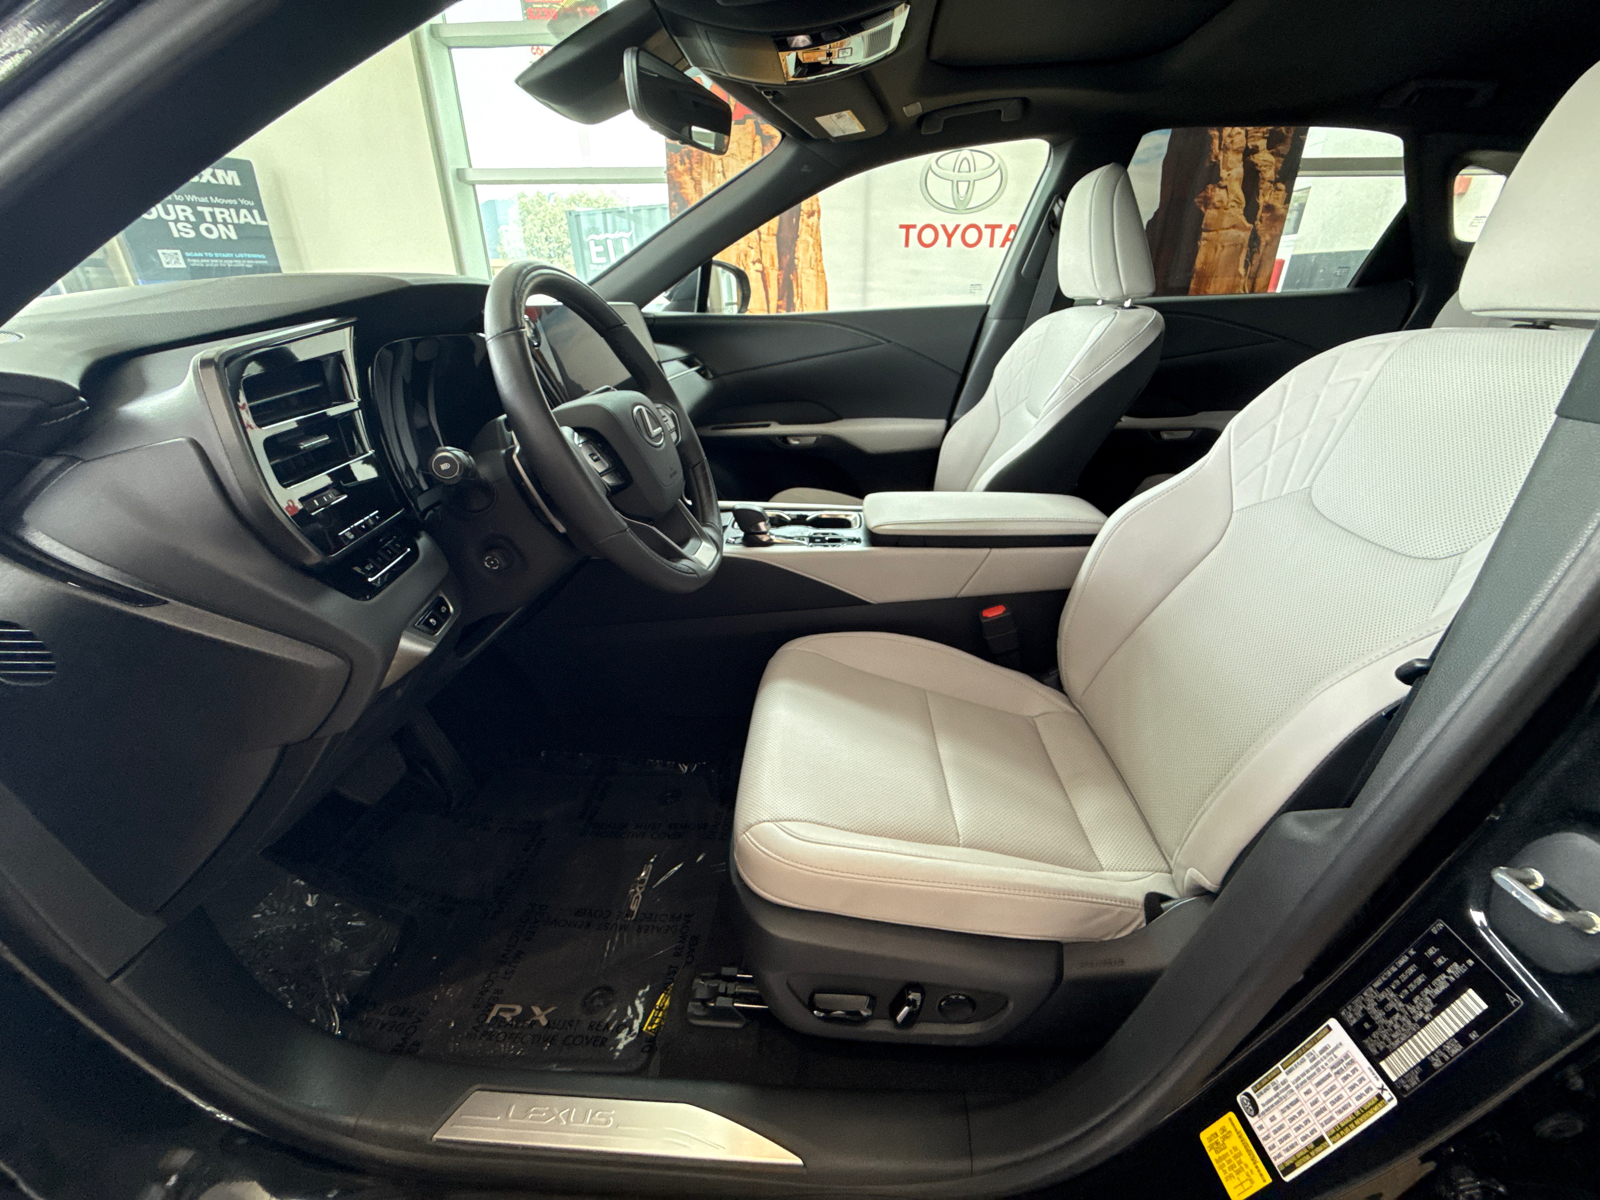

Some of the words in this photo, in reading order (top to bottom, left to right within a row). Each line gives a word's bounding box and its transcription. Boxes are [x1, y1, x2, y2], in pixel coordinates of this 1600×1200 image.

[185, 194, 209, 203] What
[210, 196, 238, 205] Moves
[238, 198, 254, 206] You
[196, 206, 268, 225] TRIAL
[168, 221, 196, 238] IS
[199, 222, 238, 240] ON
[899, 223, 1018, 248] TOYOTA
[485, 1003, 558, 1027] RX
[563, 1035, 608, 1048] COVER
[506, 1103, 615, 1128] LEXUS
